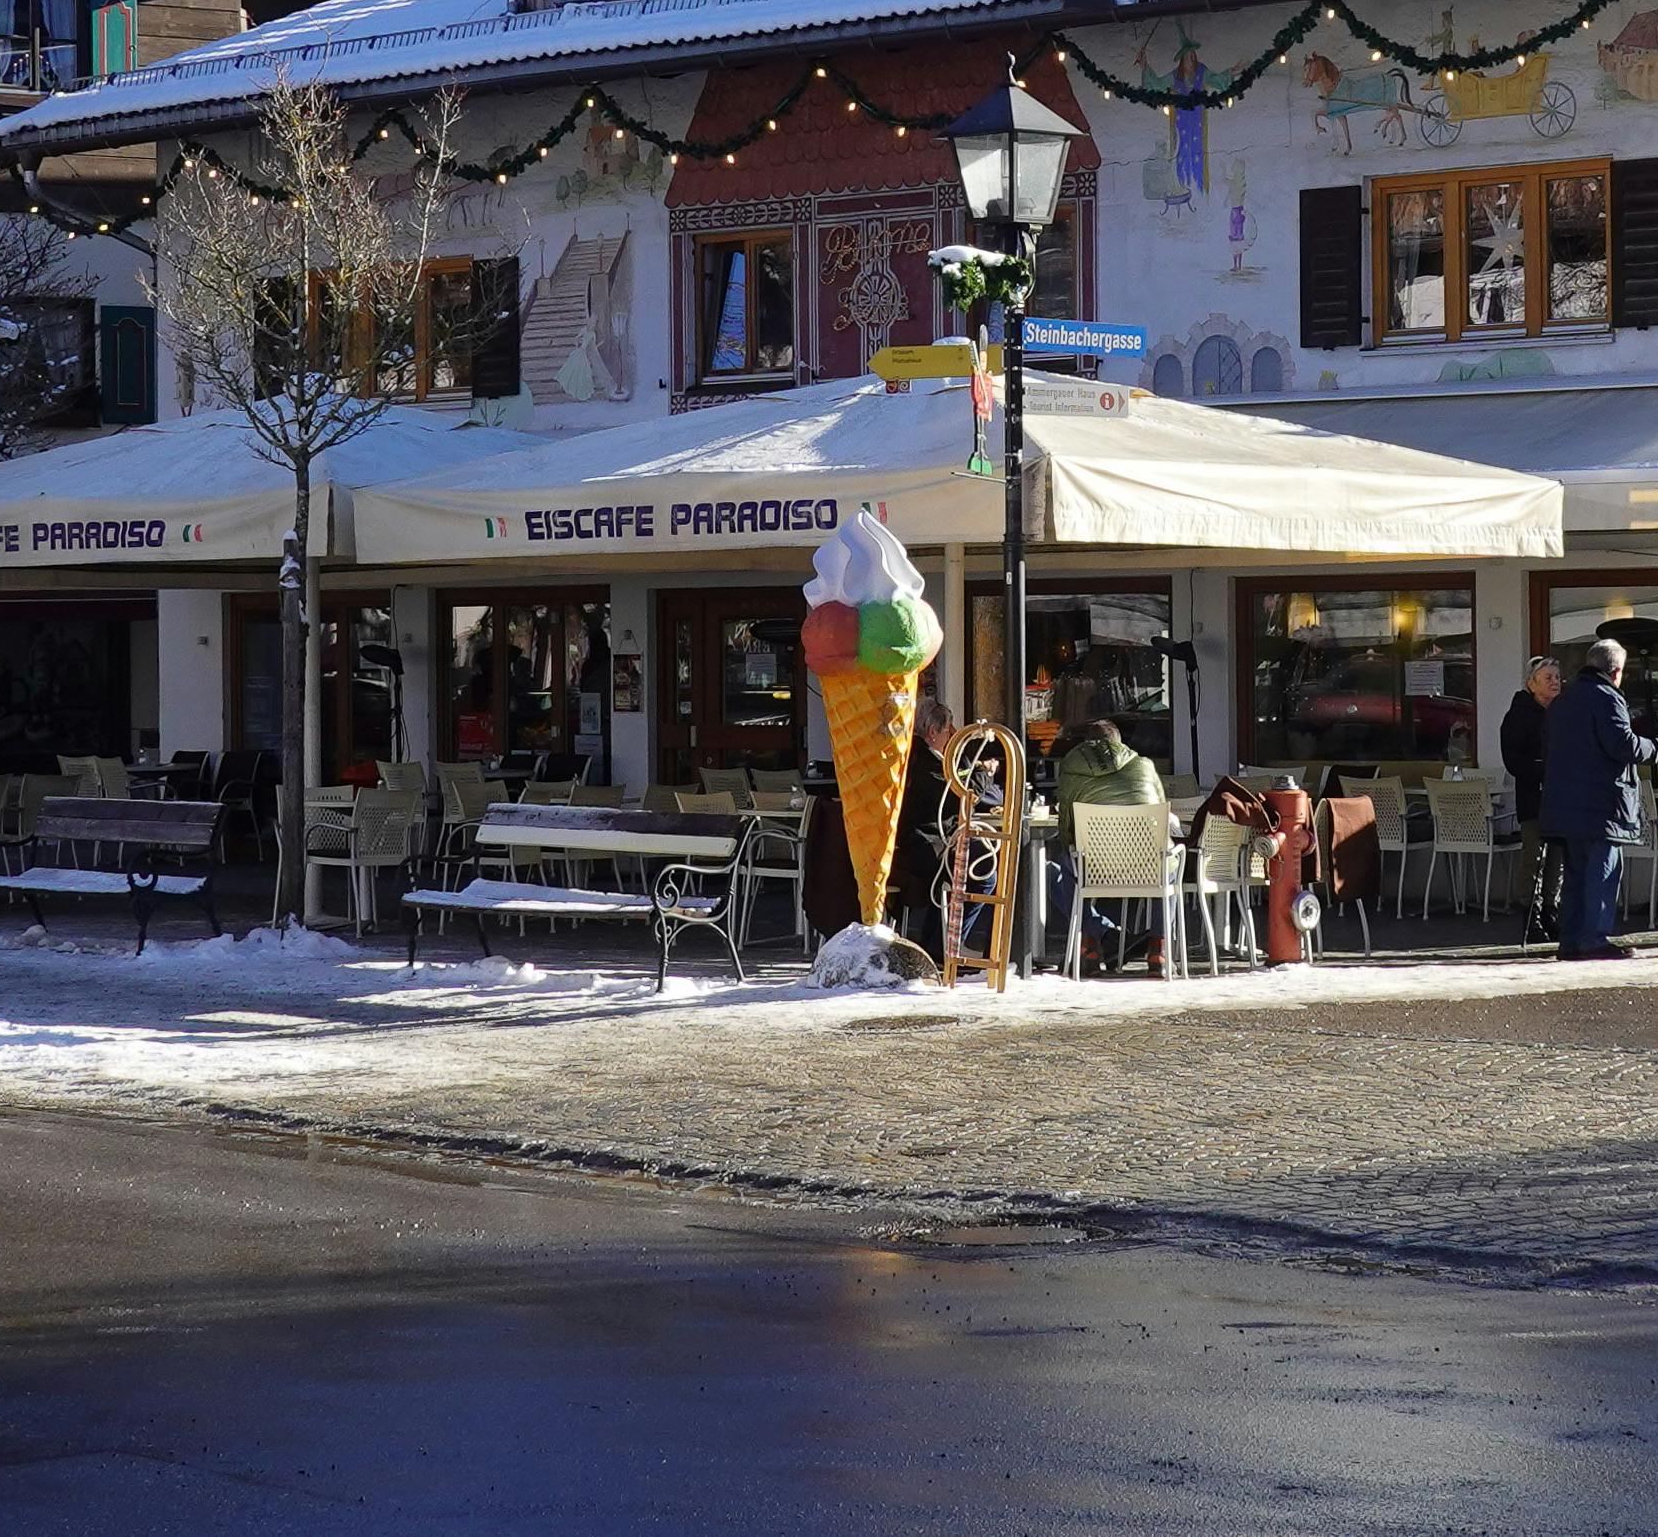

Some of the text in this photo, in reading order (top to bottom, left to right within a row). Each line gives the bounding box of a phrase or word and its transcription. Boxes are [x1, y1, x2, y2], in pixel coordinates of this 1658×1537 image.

[1025, 323, 1142, 353] Steinbachergasse
[1029, 402, 1094, 413] Tourist Information
[1077, 387, 1096, 398] Haus
[524, 498, 839, 541] EISCAFE PARADISO
[32, 519, 167, 551] PARADISO
